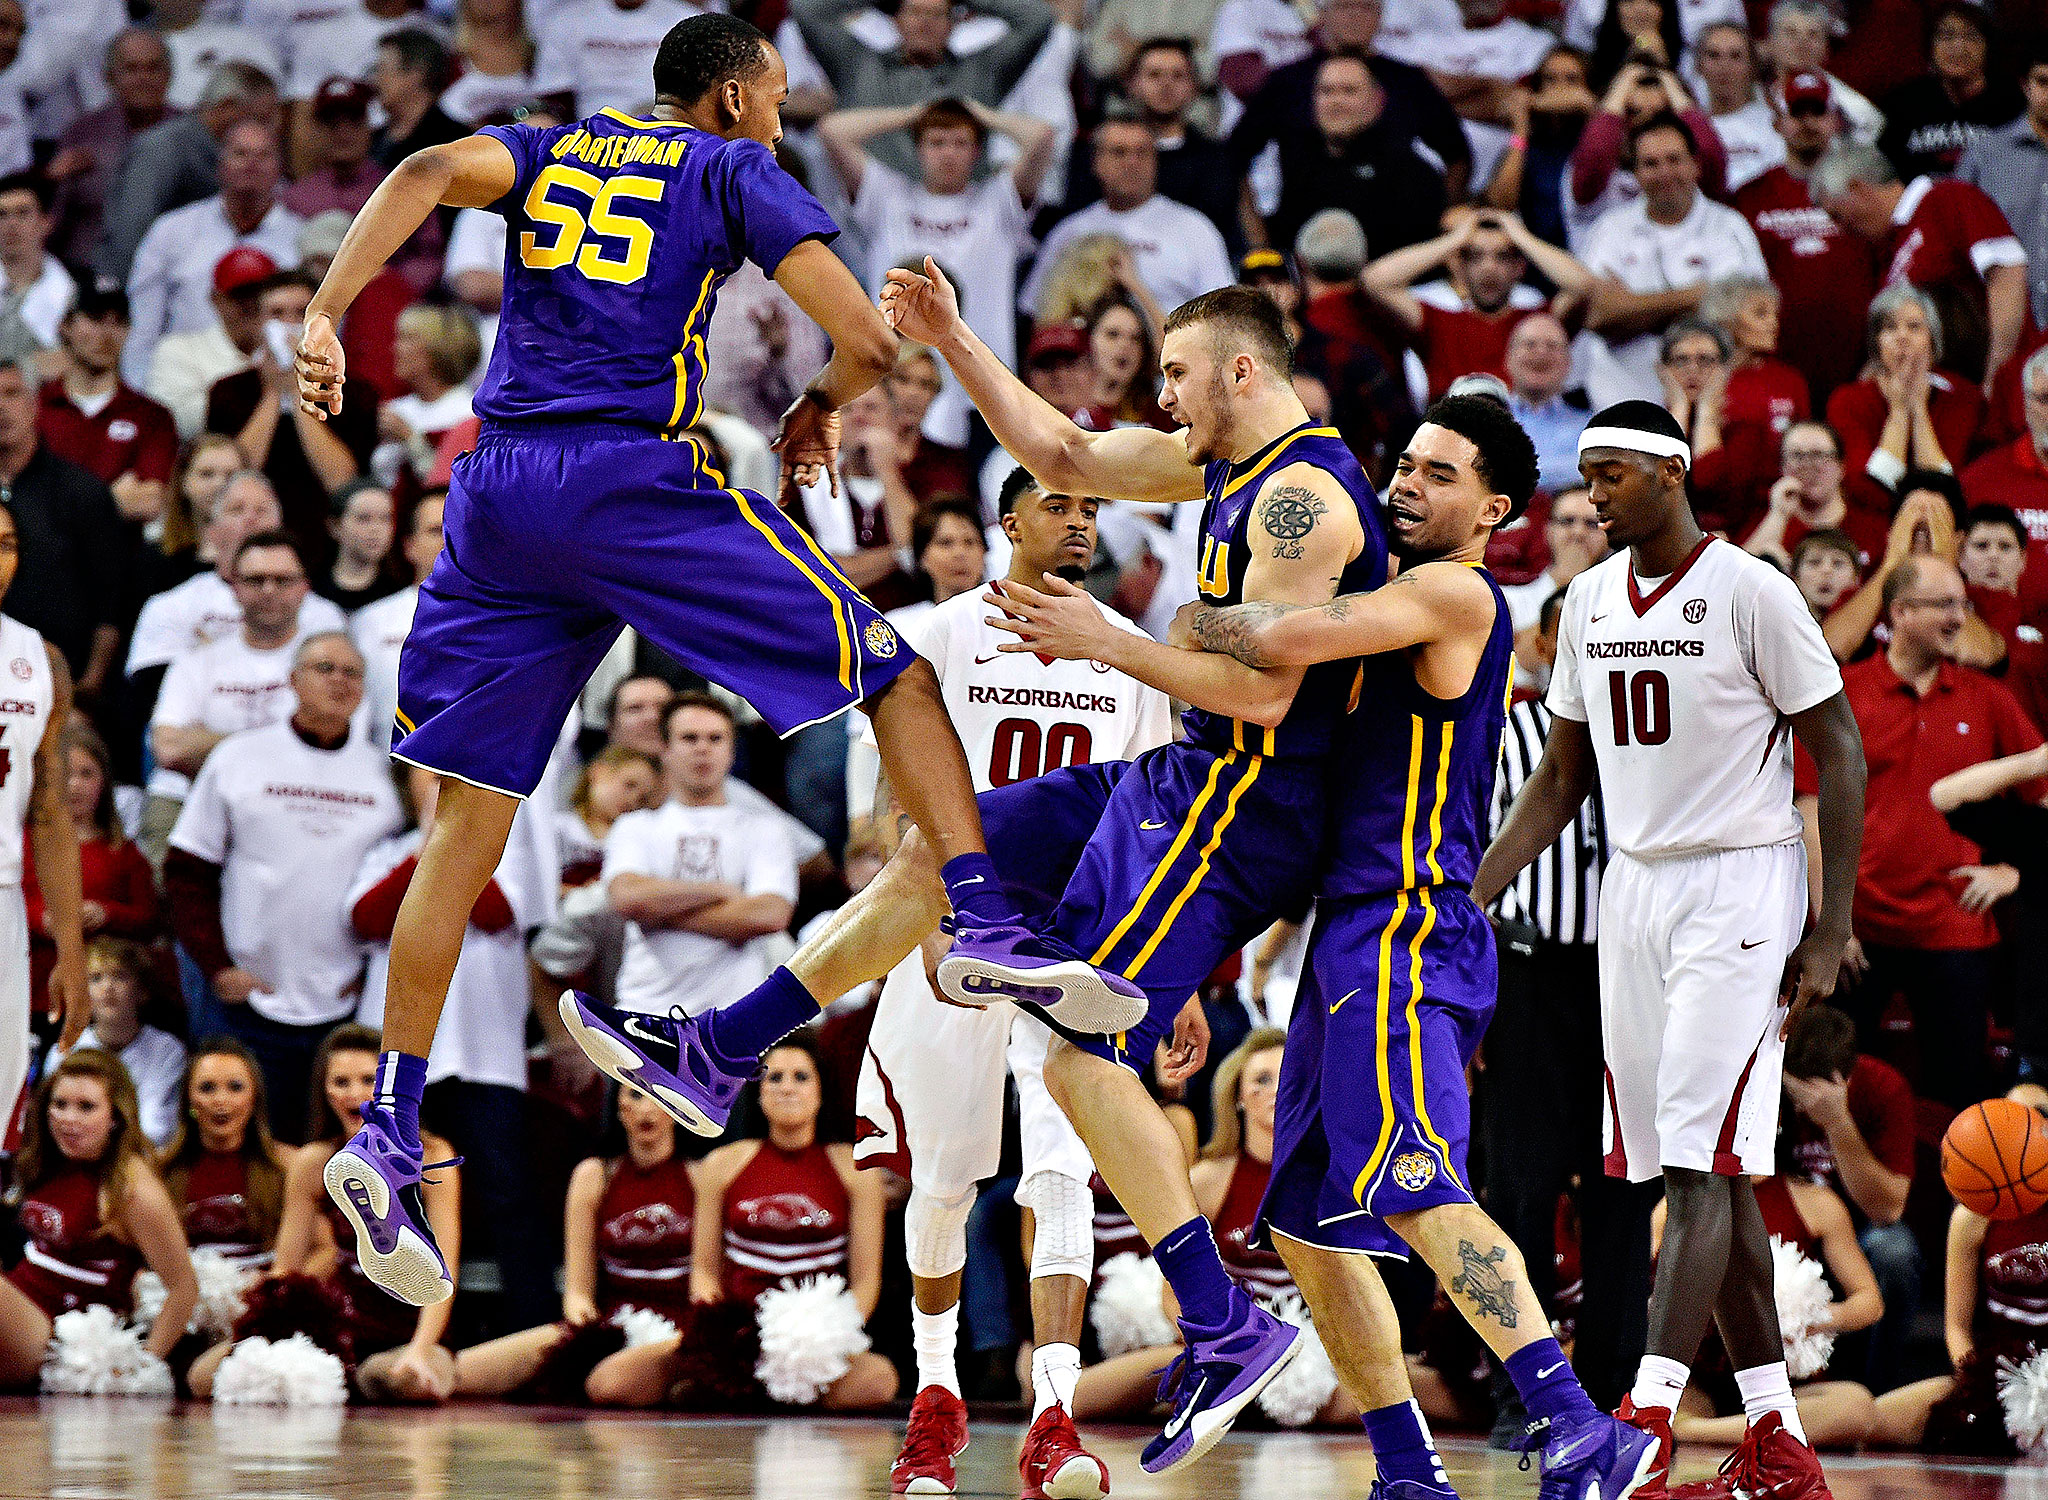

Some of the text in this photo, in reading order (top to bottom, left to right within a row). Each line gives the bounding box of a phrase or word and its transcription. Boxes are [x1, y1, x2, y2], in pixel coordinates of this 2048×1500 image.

[520, 163, 665, 286] 55
[1586, 639, 1705, 659] RAZORBACKS
[968, 685, 1117, 714] RAZORBACKS
[1608, 669, 1672, 747] 10
[988, 717, 1093, 790] 00
